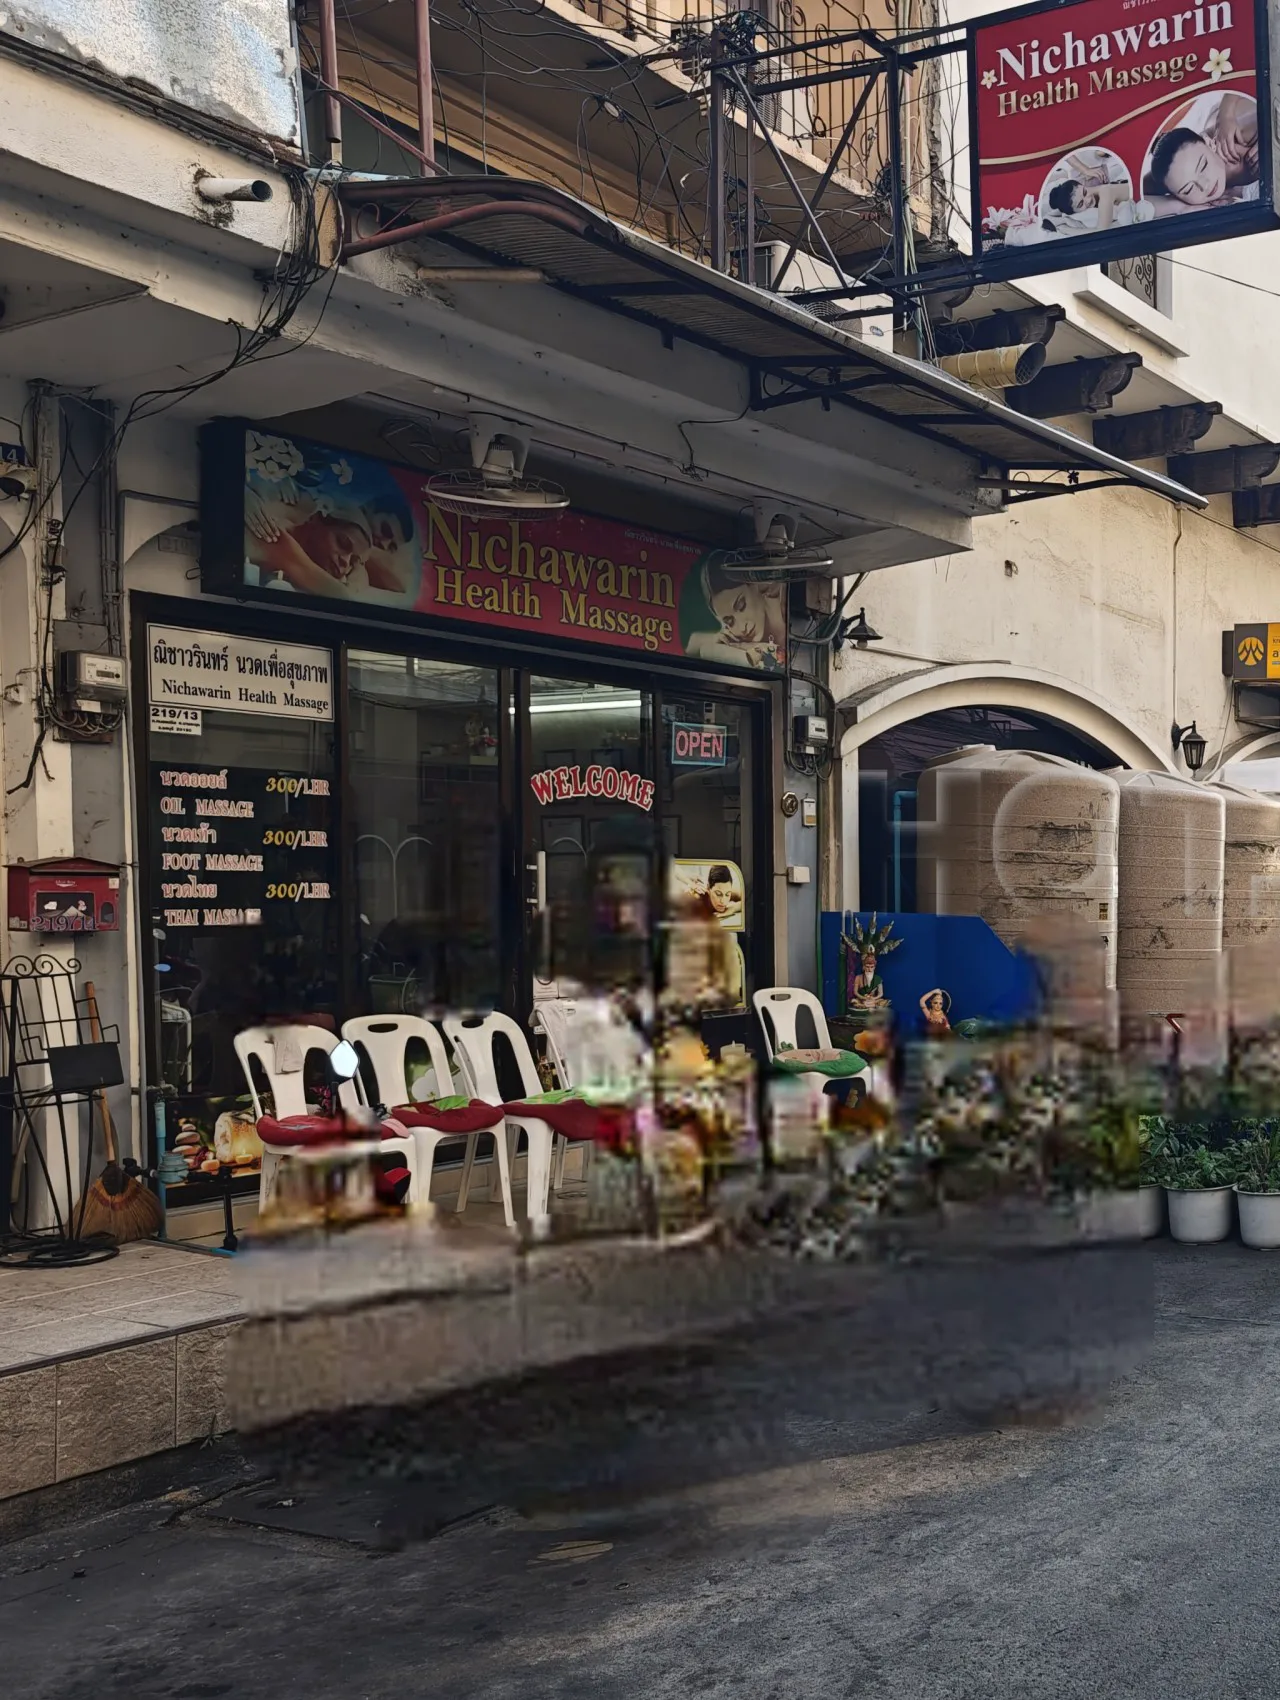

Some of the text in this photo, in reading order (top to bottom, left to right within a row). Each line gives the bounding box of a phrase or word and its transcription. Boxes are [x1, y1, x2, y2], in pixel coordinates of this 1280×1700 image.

[996, 0, 1234, 87] Nichawarin
[997, 53, 1199, 118] Health Massage
[423, 500, 676, 609] Nichawarin
[434, 565, 673, 651] Health Massage
[153, 638, 328, 689] ณิชาวรินทร์ นวดเพื่อสุขภาพ
[151, 708, 198, 720] 219/13
[162, 678, 329, 713] Nichawarin Health Massage
[675, 730, 723, 757] OPEN
[160, 796, 255, 818] OIL MASSAGE
[530, 765, 656, 811] WELCOME
[162, 852, 264, 872] FOOT MASSAGE
[164, 908, 200, 926] THAI
